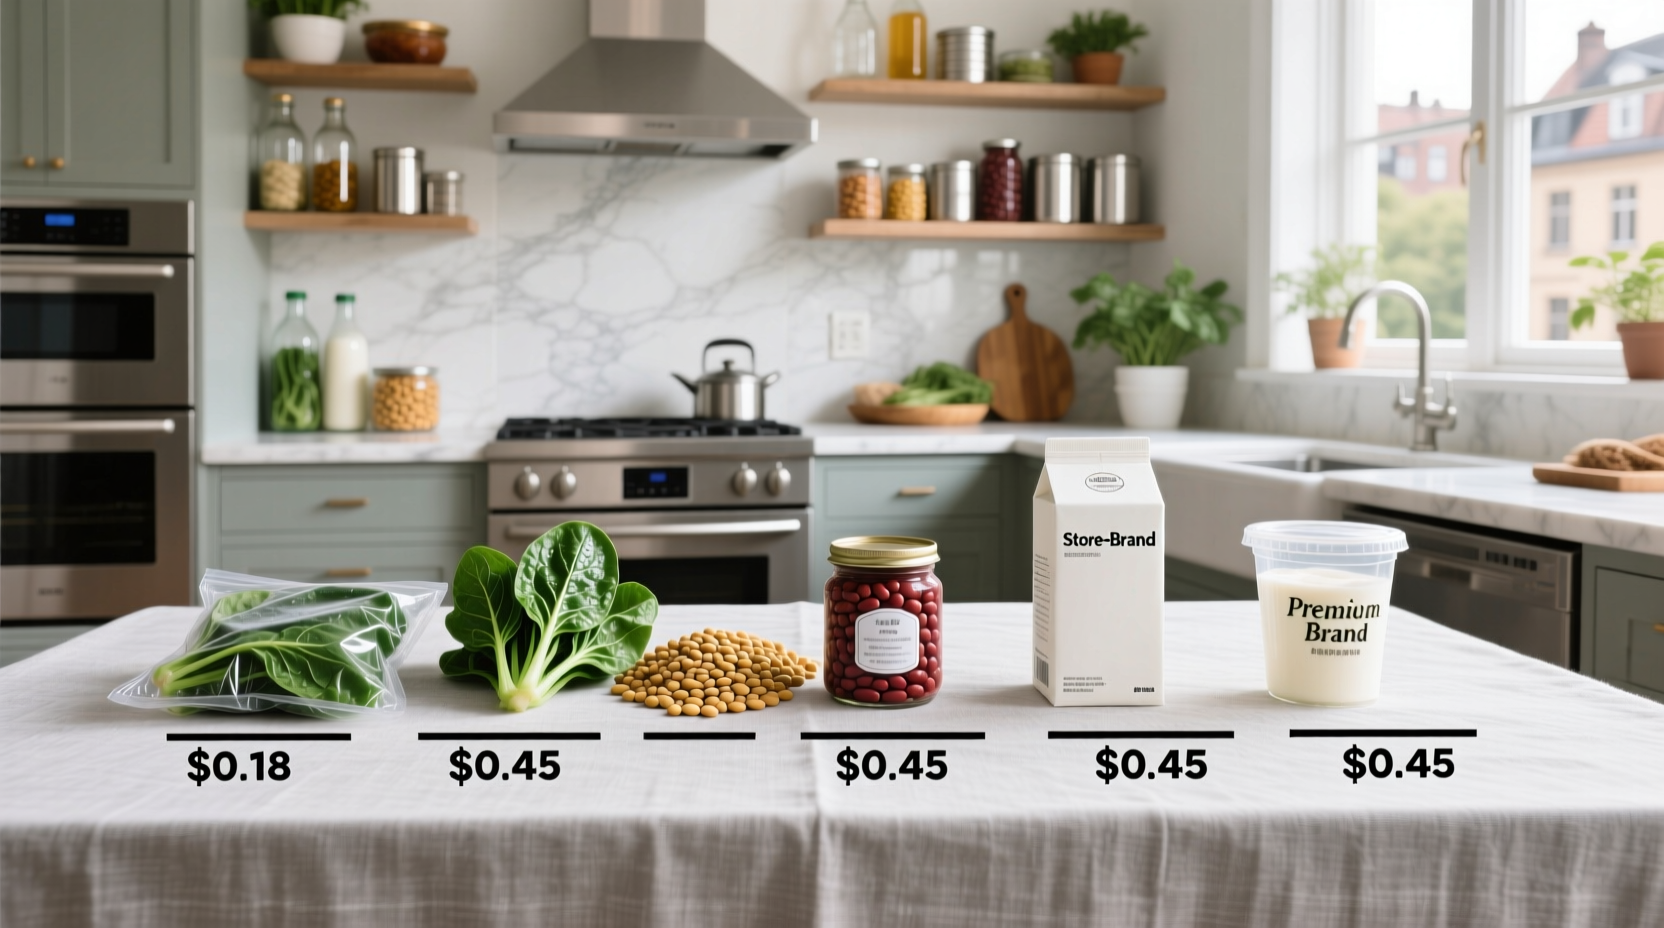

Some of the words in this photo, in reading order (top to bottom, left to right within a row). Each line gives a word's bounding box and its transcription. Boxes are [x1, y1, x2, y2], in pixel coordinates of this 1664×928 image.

[1063, 531, 1156, 547] Store-Brand
[1286, 596, 1380, 620] Premium
[1304, 621, 1368, 643] Brand
